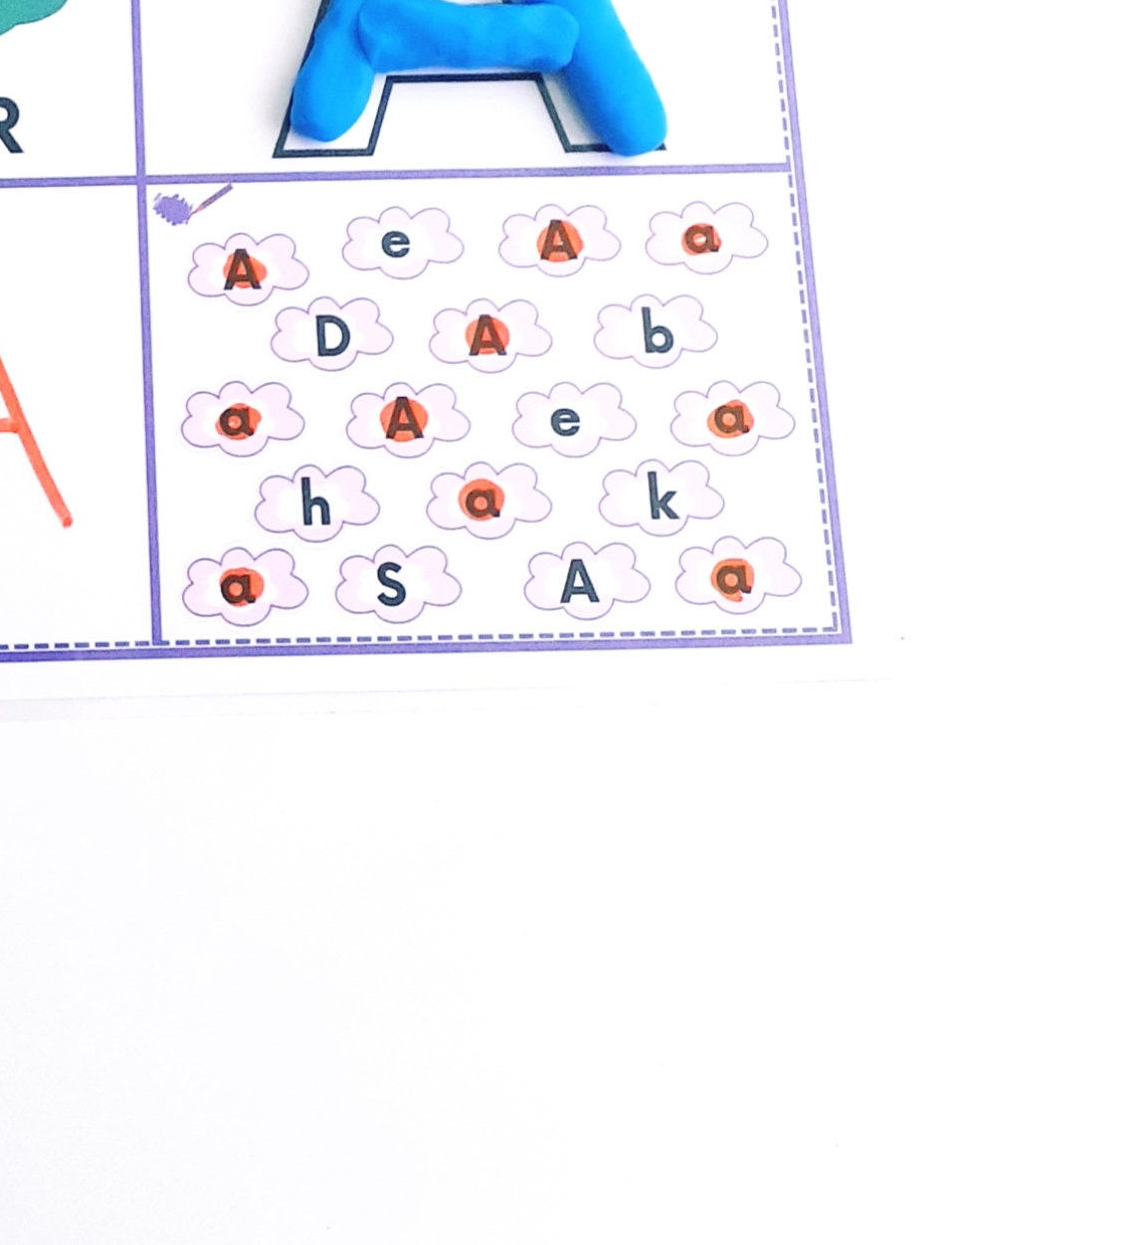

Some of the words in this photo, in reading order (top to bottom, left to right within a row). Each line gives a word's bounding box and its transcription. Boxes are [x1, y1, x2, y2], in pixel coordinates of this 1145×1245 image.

[381, 231, 410, 258] e
[541, 220, 577, 260] A
[685, 226, 719, 253] a
[224, 249, 261, 290] A
[316, 315, 350, 357] D
[469, 315, 507, 356] A
[642, 307, 674, 353] b
[219, 408, 254, 436] a
[386, 396, 424, 439] A
[551, 408, 580, 436] e
[714, 405, 749, 433] a
[301, 477, 331, 526] h
[466, 490, 500, 518] a
[647, 471, 679, 520] k
[220, 575, 256, 604] a
[377, 562, 406, 607] S
[560, 559, 600, 603] A
[717, 566, 751, 594] a
